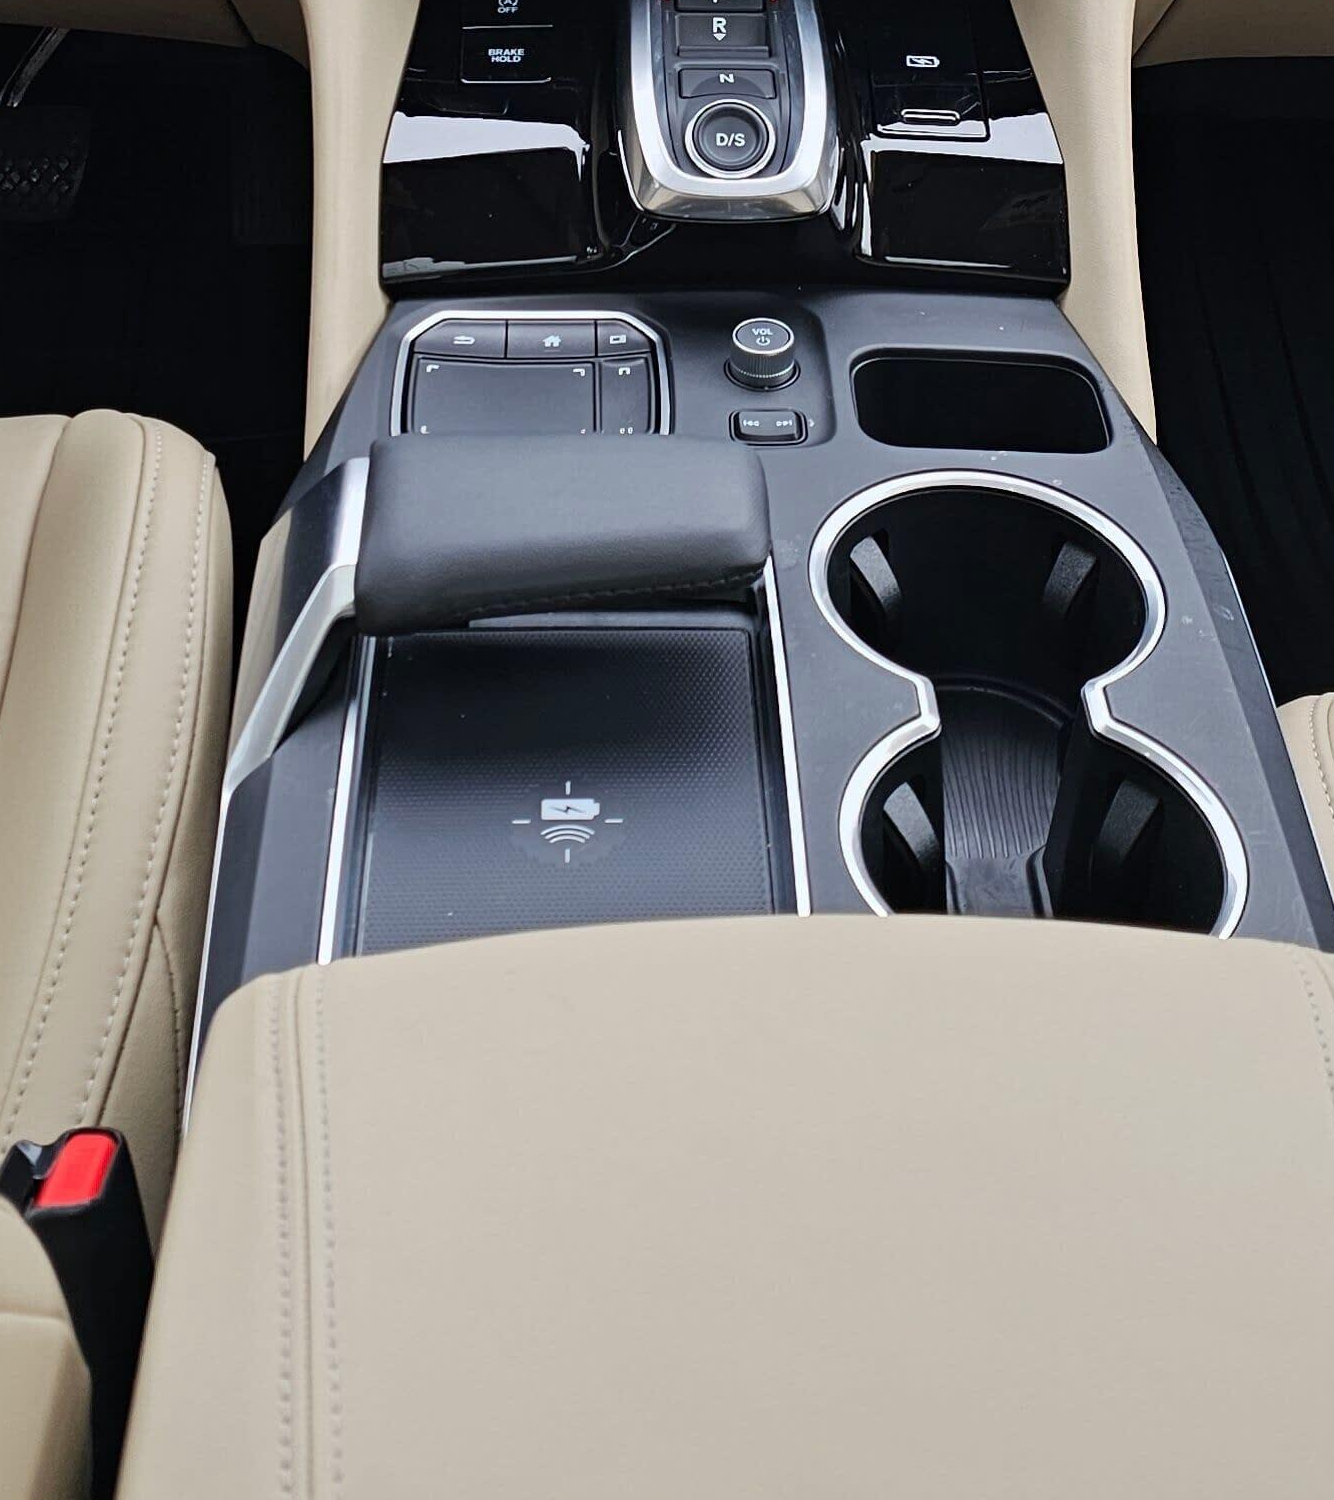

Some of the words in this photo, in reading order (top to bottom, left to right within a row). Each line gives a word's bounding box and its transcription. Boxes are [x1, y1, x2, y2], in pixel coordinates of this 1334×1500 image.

[496, 5, 519, 15] OFF
[713, 18, 726, 33] R
[488, 48, 525, 56] BRAKE
[491, 55, 522, 64] HOLD
[720, 74, 734, 82] N
[715, 132, 747, 148] D/S
[751, 327, 774, 337] VOL
